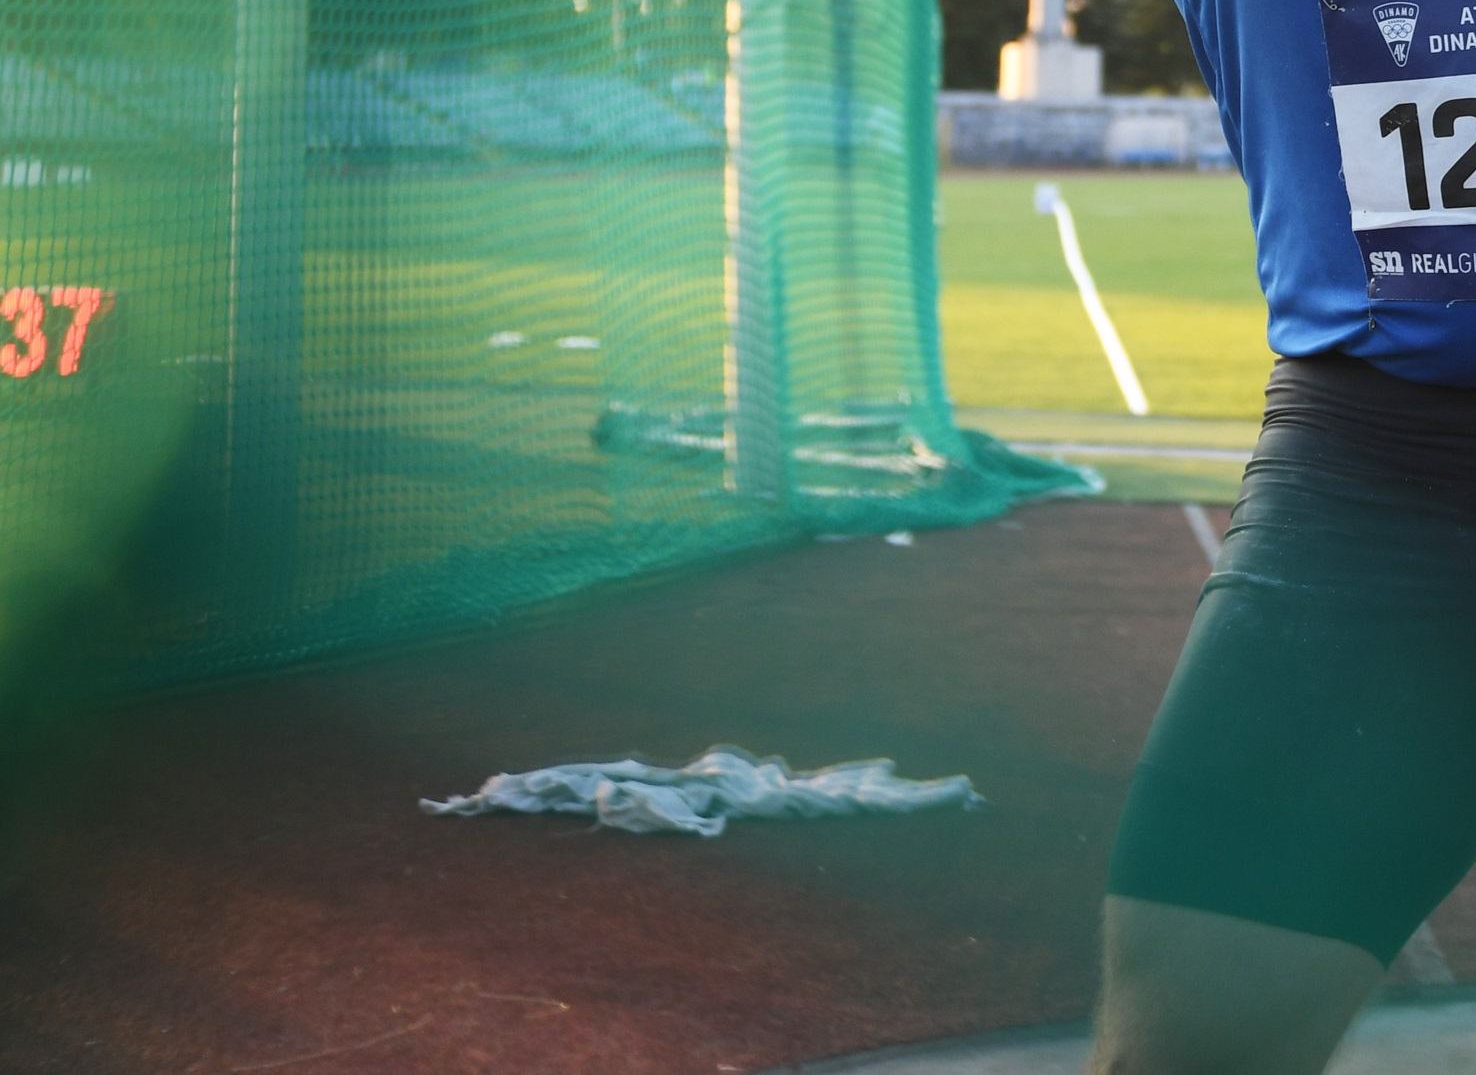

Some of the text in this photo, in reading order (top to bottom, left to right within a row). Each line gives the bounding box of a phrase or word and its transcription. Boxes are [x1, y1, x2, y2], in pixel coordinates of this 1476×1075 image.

[1378, 7, 1414, 20] DINAMO
[1394, 43, 1406, 62] AK
[0, 285, 114, 378] 37
